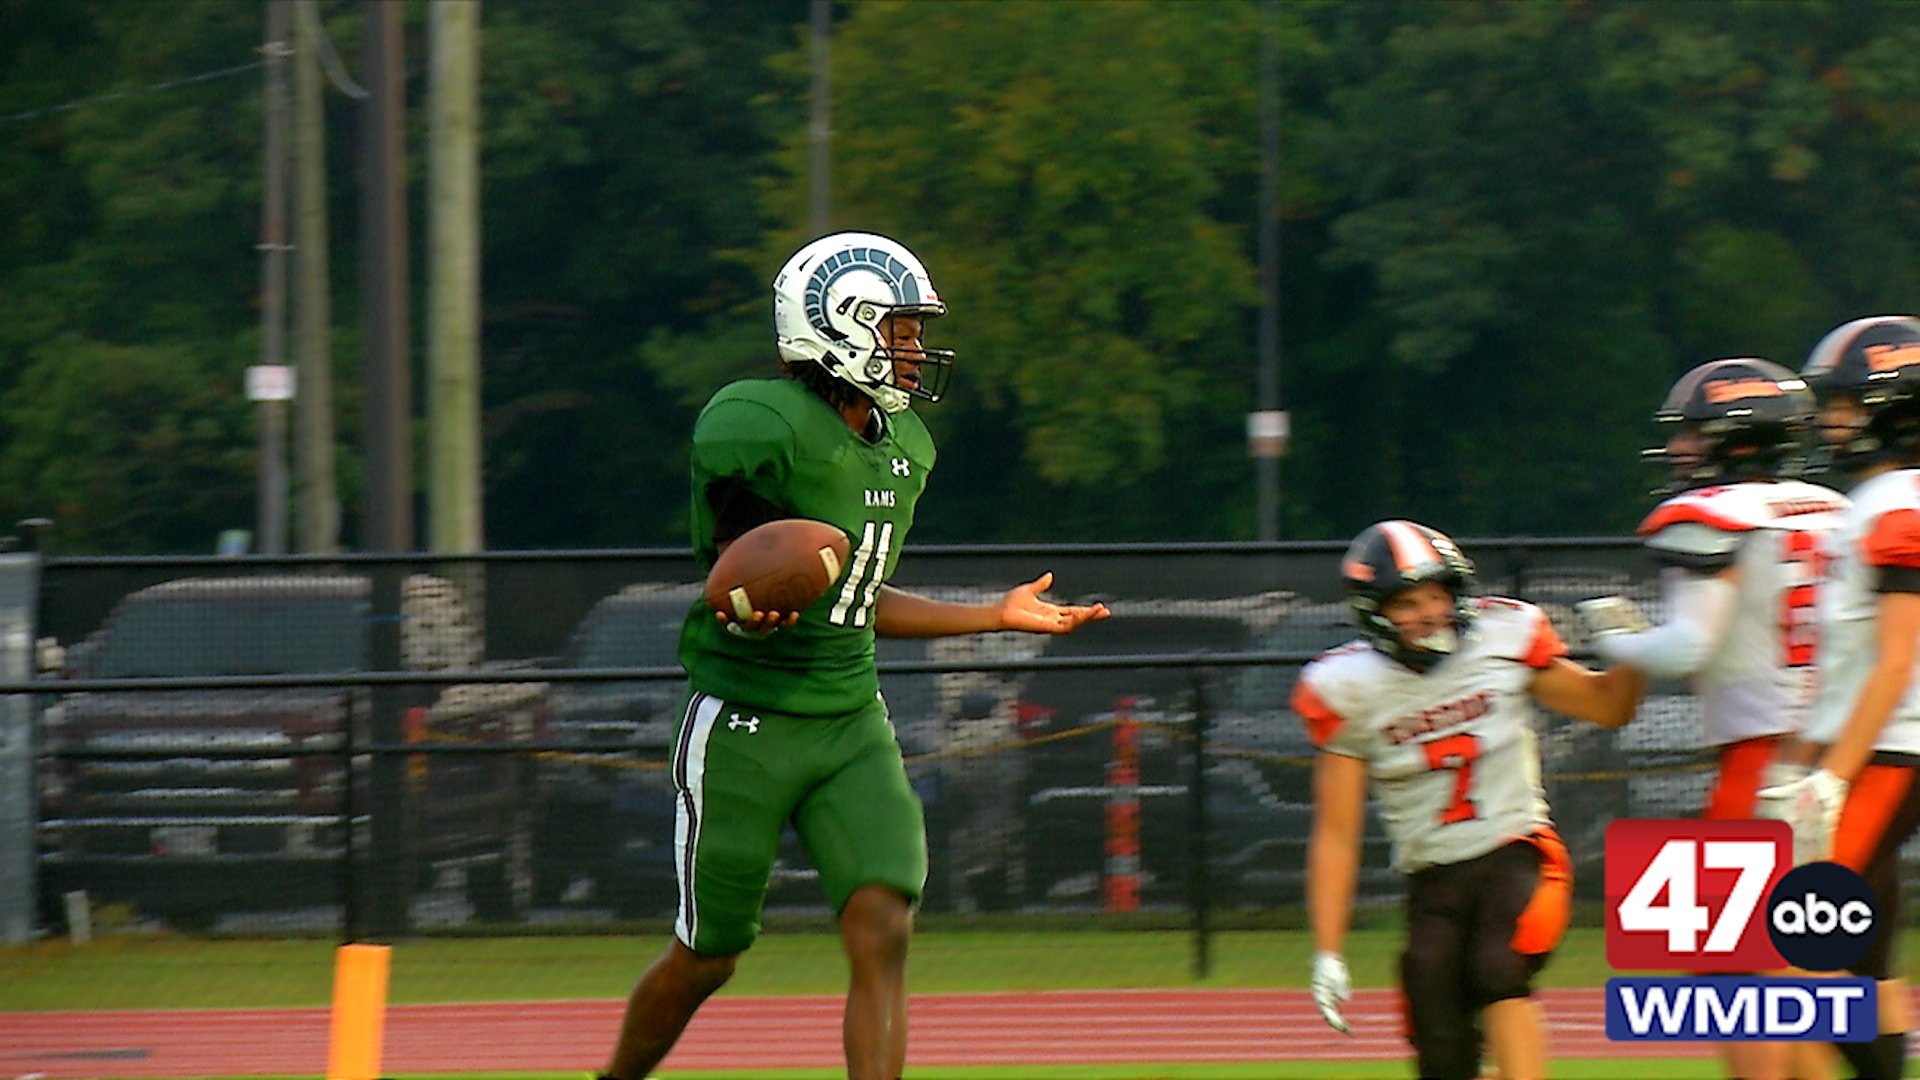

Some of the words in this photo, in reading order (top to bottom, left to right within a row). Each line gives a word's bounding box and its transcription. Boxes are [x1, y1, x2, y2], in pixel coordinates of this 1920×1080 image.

[864, 489, 896, 507] RAMS
[829, 522, 893, 626] 11
[1421, 733, 1481, 825] 7
